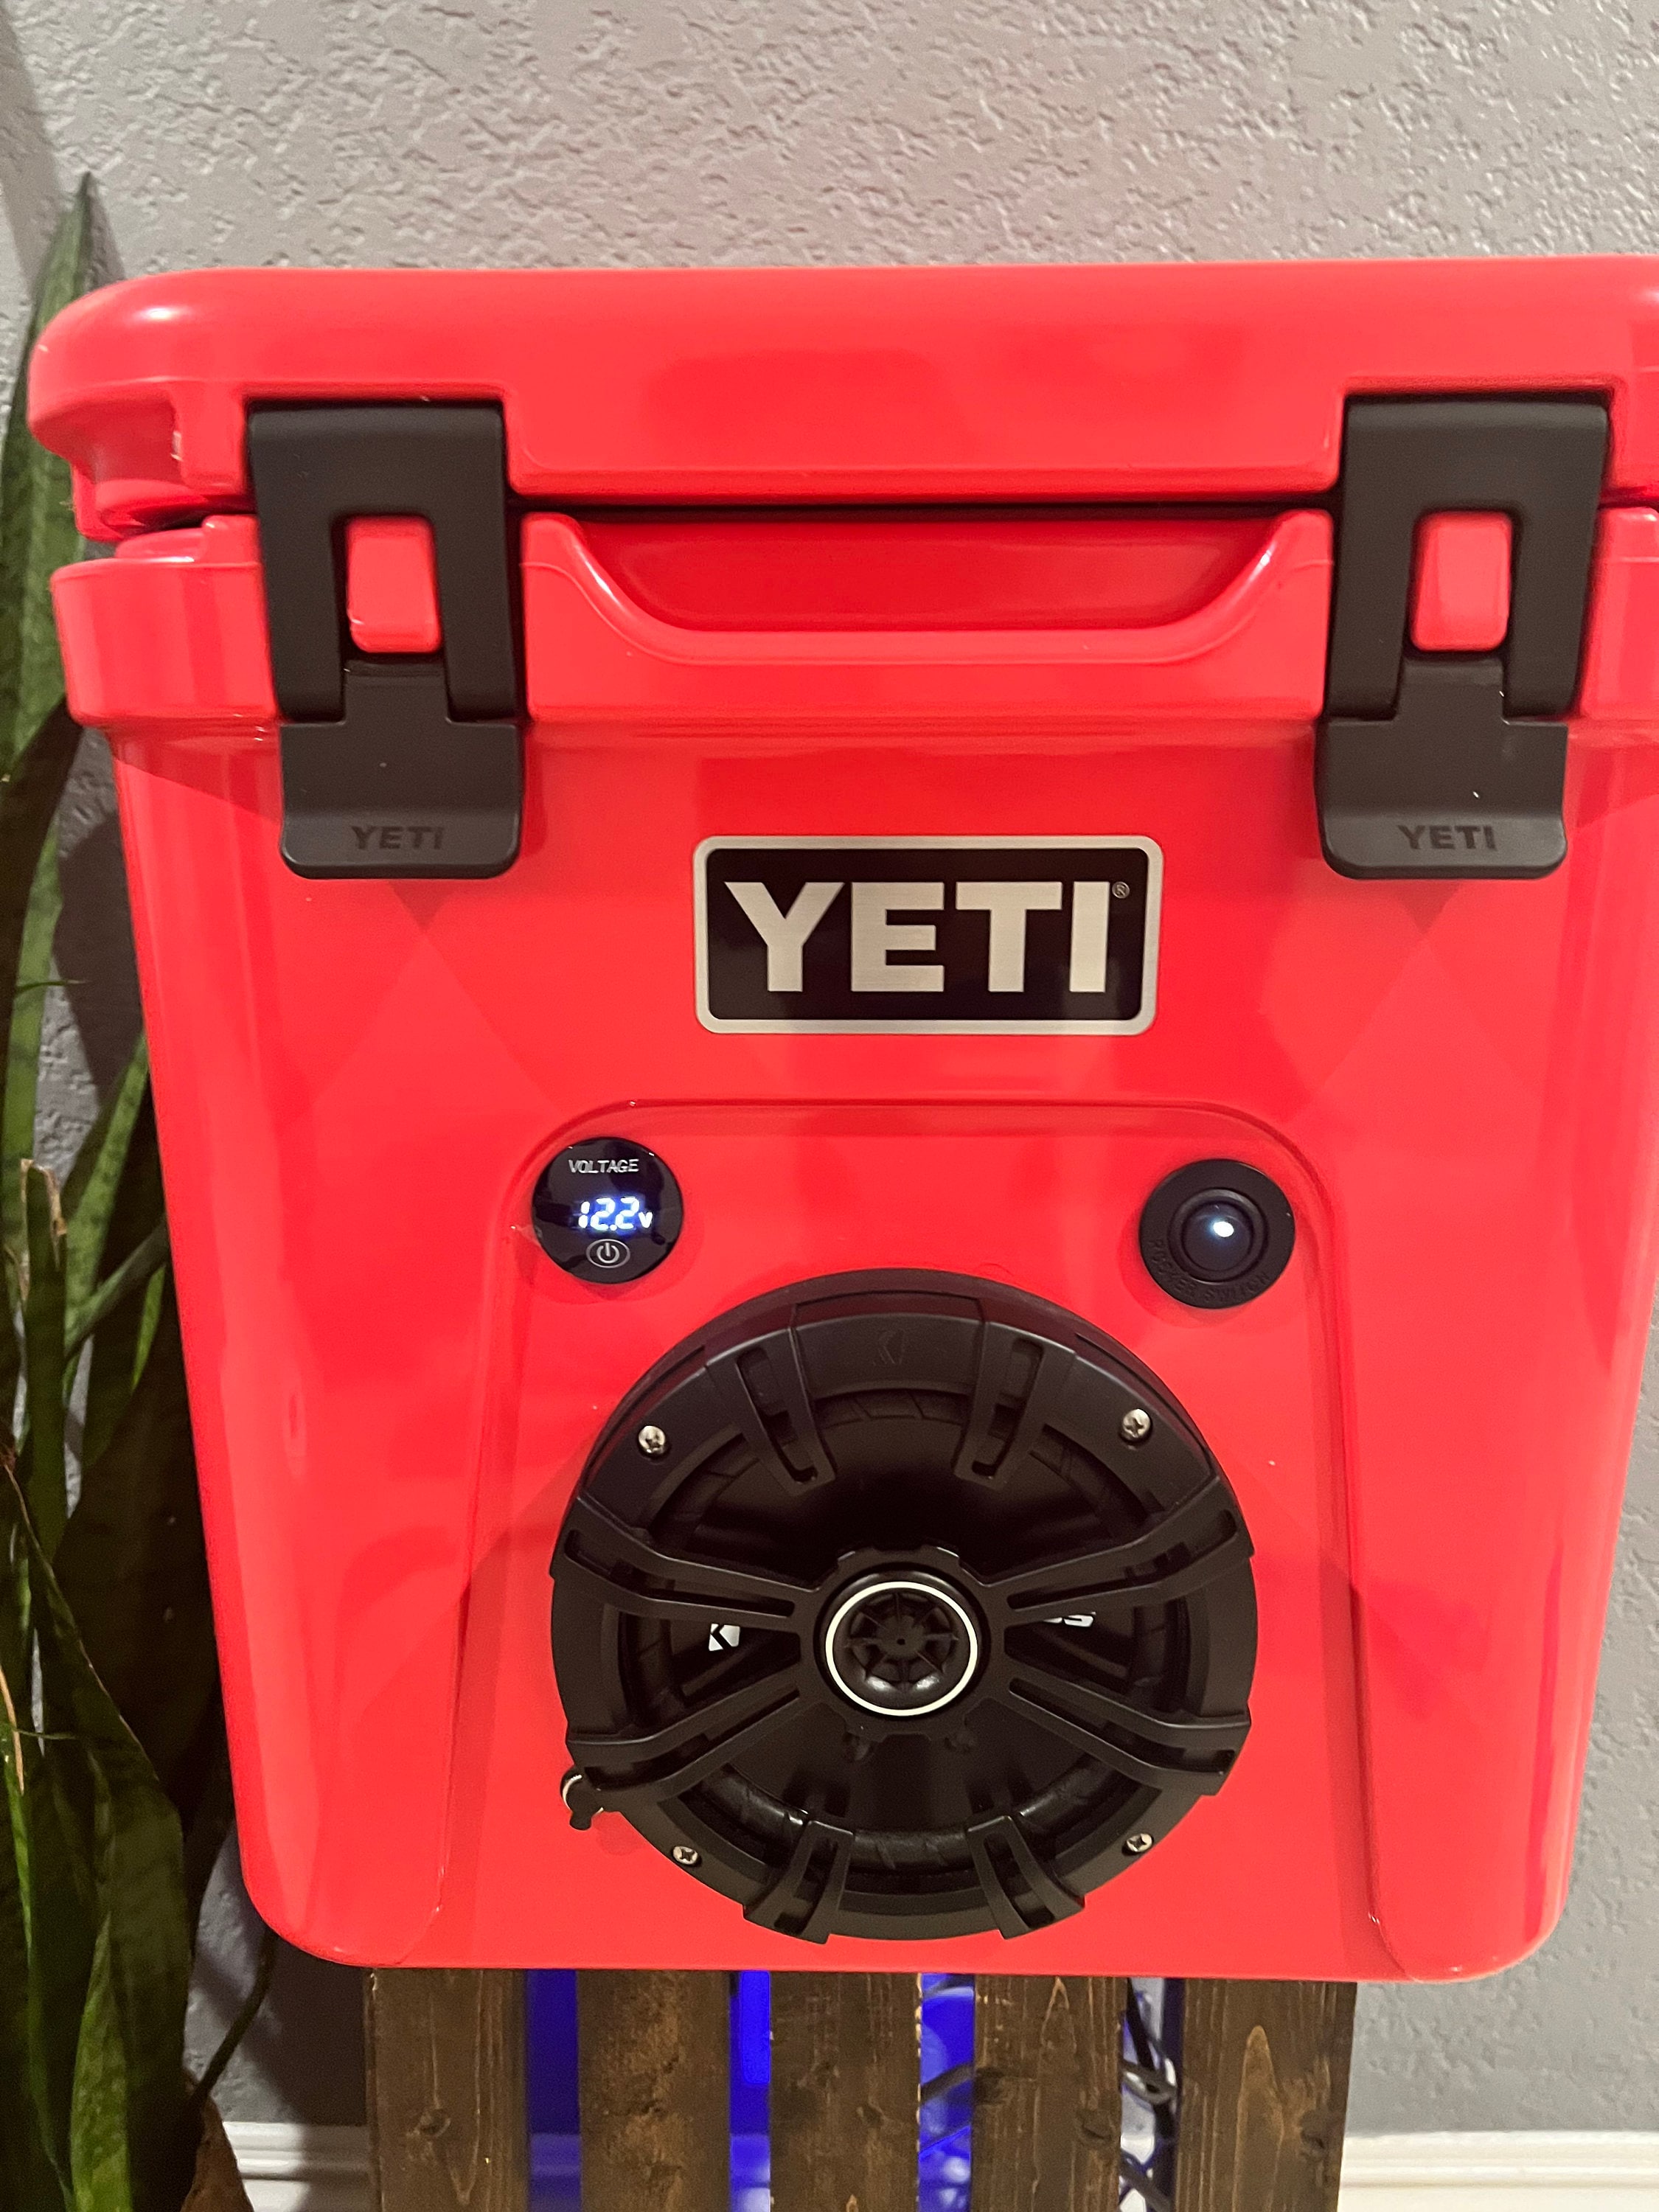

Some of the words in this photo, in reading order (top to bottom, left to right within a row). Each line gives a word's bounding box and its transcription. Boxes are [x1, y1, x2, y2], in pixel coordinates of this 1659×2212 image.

[350, 825, 445, 849] YETI
[1397, 824, 1498, 851] YETI
[568, 1158, 639, 1174] VOLTAGE
